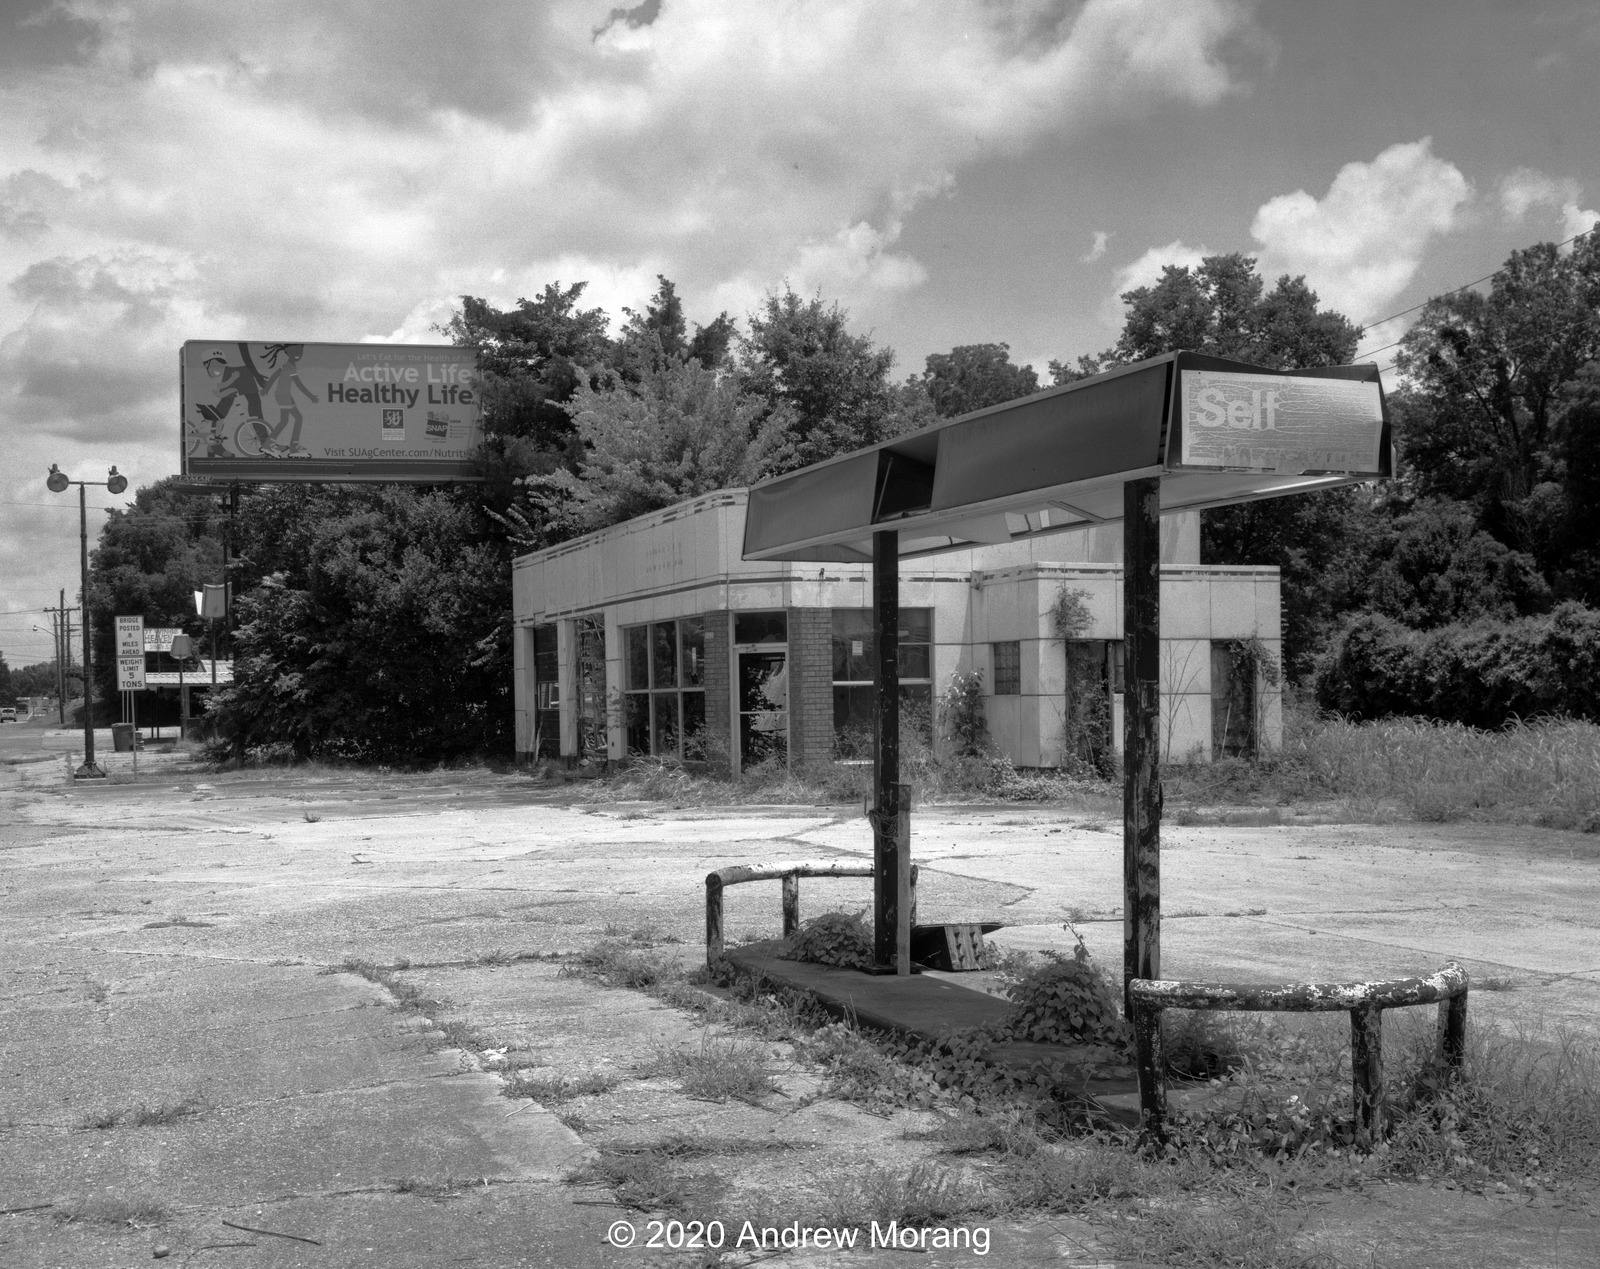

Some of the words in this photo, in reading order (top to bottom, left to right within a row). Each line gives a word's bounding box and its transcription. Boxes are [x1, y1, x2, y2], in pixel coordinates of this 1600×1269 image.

[357, 353, 377, 361] Let's
[379, 353, 391, 361] Eat
[394, 353, 406, 361] for
[408, 353, 422, 362] the
[423, 354, 450, 362] Health
[343, 361, 419, 383] Active
[426, 363, 472, 384] Life
[327, 382, 420, 409] Healthy
[427, 384, 473, 405] Life
[1196, 386, 1280, 430] Self
[426, 424, 448, 432] SNAP
[324, 447, 346, 457] Visit
[121, 680, 143, 688] TONS
